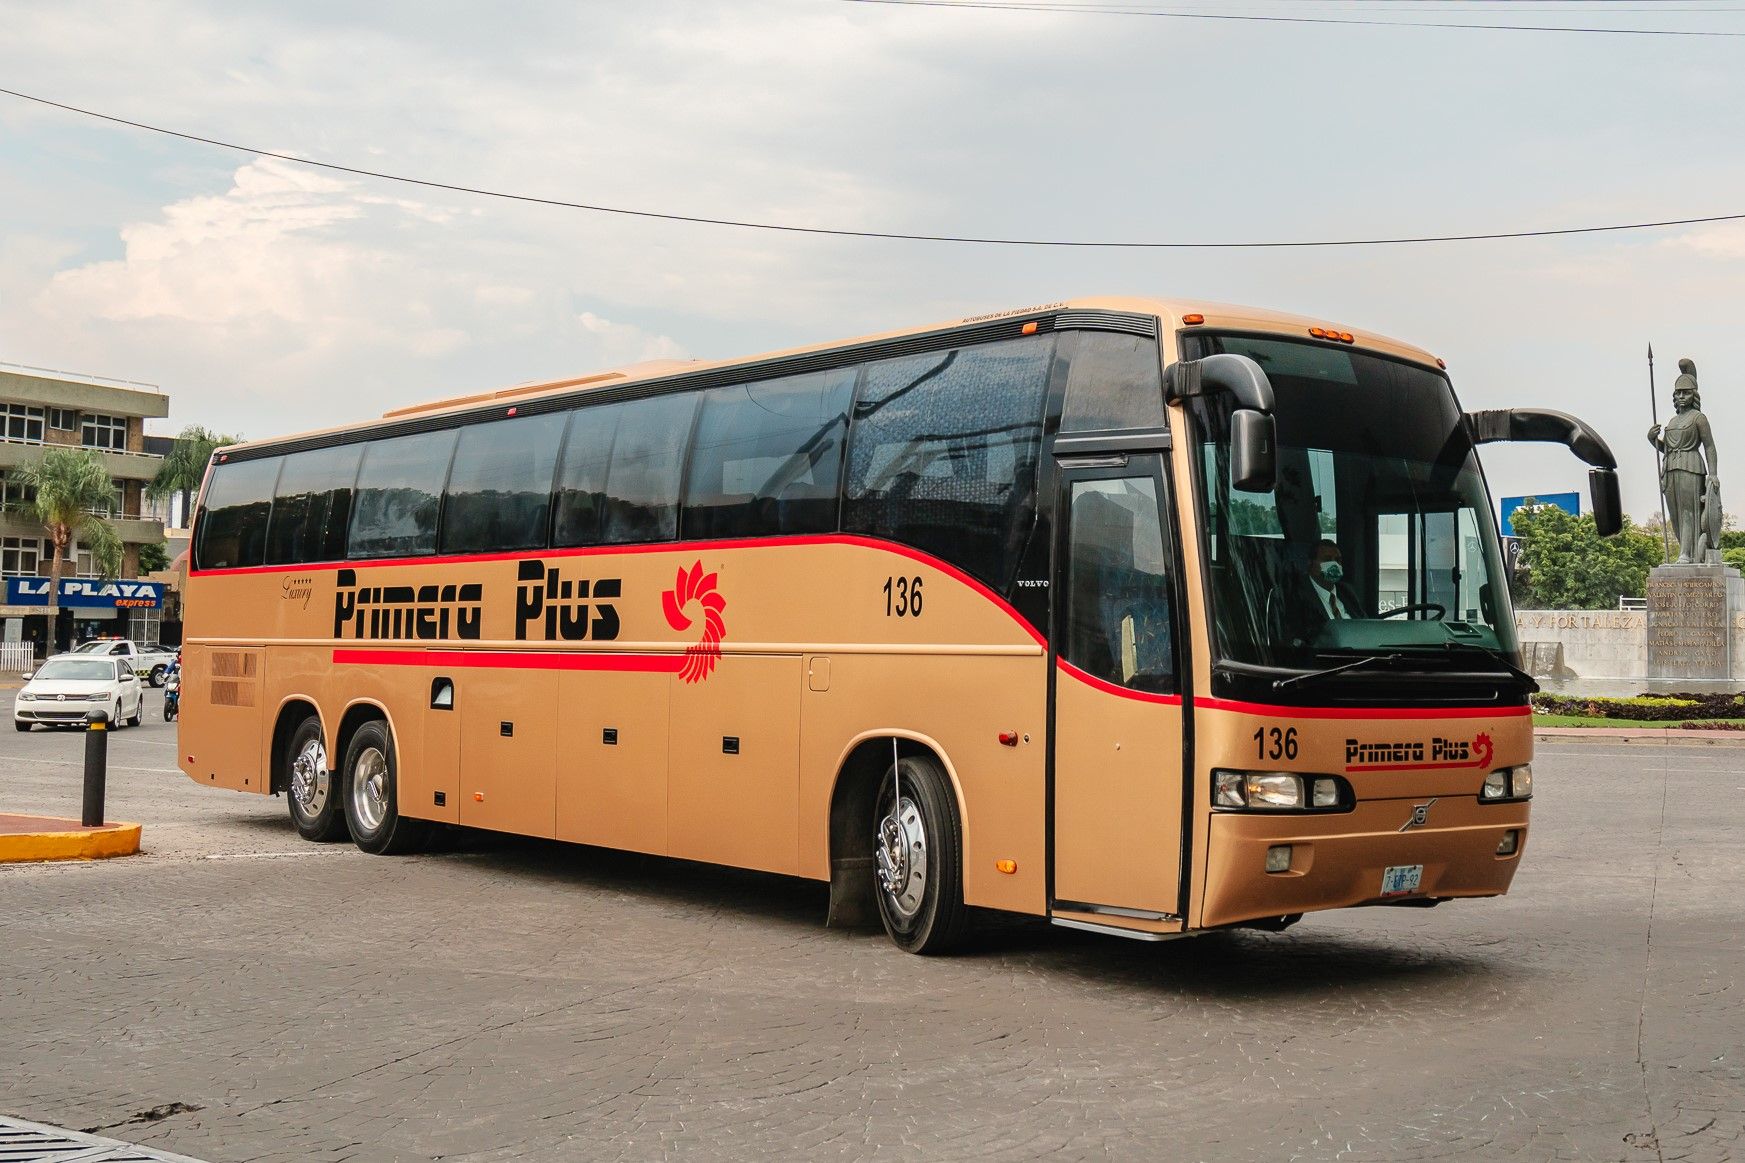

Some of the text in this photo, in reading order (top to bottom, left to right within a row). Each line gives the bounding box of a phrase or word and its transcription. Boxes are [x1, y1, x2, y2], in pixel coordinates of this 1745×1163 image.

[961, 312, 994, 325] AUTOBUSES
[64, 582, 157, 598] PLAYA
[1017, 580, 1050, 588] VOLVO
[115, 597, 157, 608] express
[334, 560, 621, 640] Primera Plus
[883, 576, 924, 618] 136
[1532, 616, 1543, 629] Y
[1548, 616, 1645, 629] FORTALEZA
[1253, 727, 1299, 760] 136
[1345, 737, 1469, 764] Primera Plus
